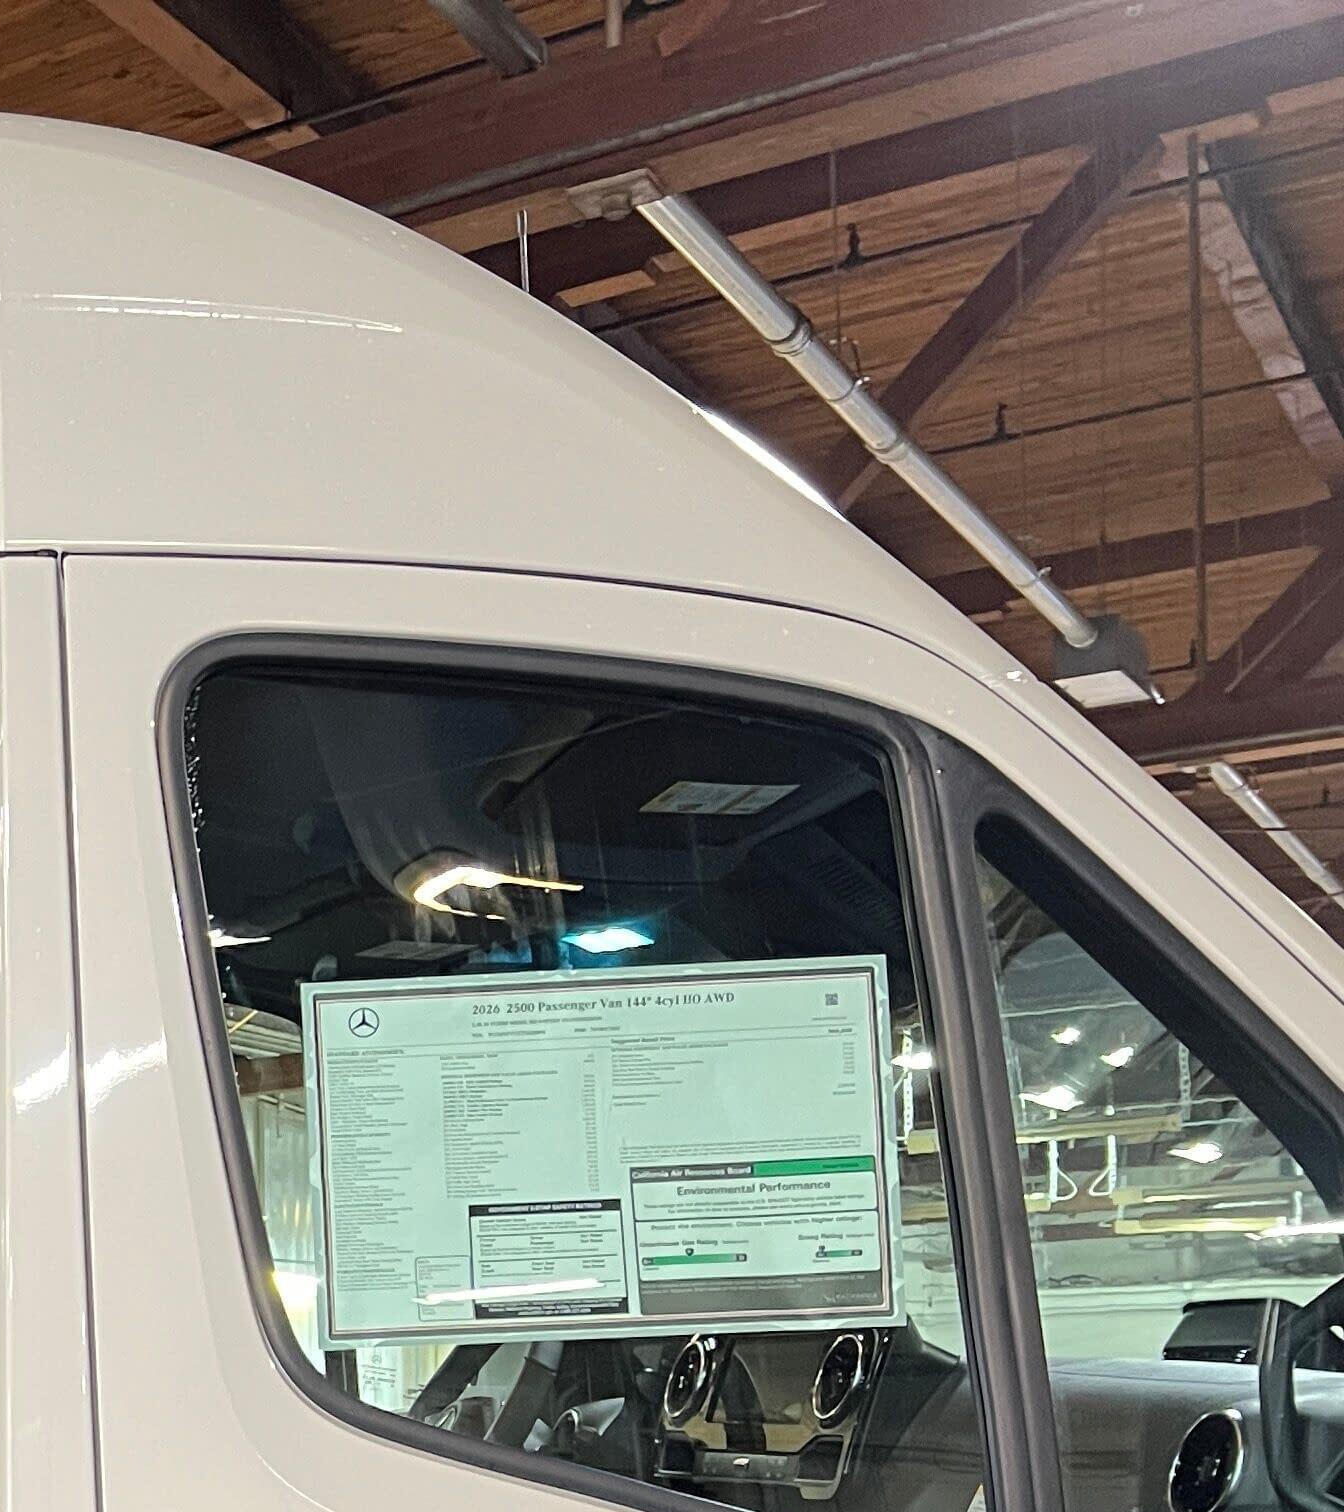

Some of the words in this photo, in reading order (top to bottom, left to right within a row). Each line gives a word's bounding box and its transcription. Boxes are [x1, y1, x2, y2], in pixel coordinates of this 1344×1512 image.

[472, 1004, 501, 1015] 2026
[506, 1002, 535, 1014] 2500
[538, 1000, 598, 1012] Passenger
[600, 998, 623, 1008] Van
[704, 992, 735, 1004] AWD
[676, 1183, 756, 1196] Environmental
[759, 1180, 831, 1193] Performance
